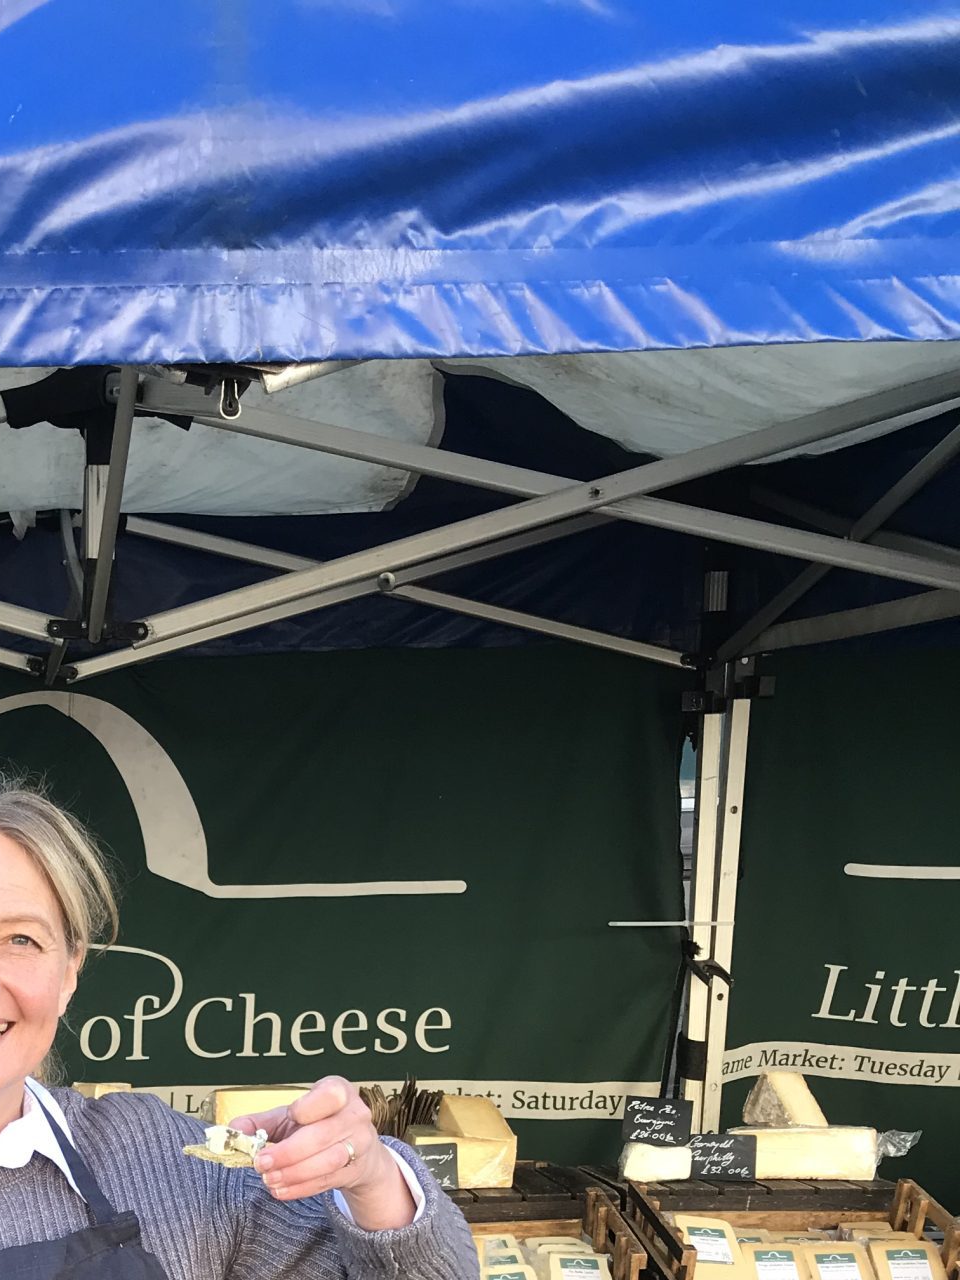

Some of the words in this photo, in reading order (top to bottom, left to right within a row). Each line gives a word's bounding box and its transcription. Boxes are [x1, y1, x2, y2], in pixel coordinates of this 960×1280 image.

[79, 990, 183, 1061] of
[185, 993, 452, 1058] Cheese
[722, 1056, 752, 1075] ame
[757, 1049, 845, 1071] Market:
[854, 1054, 950, 1083] Tuesday
[511, 1090, 624, 1115] Saturday
